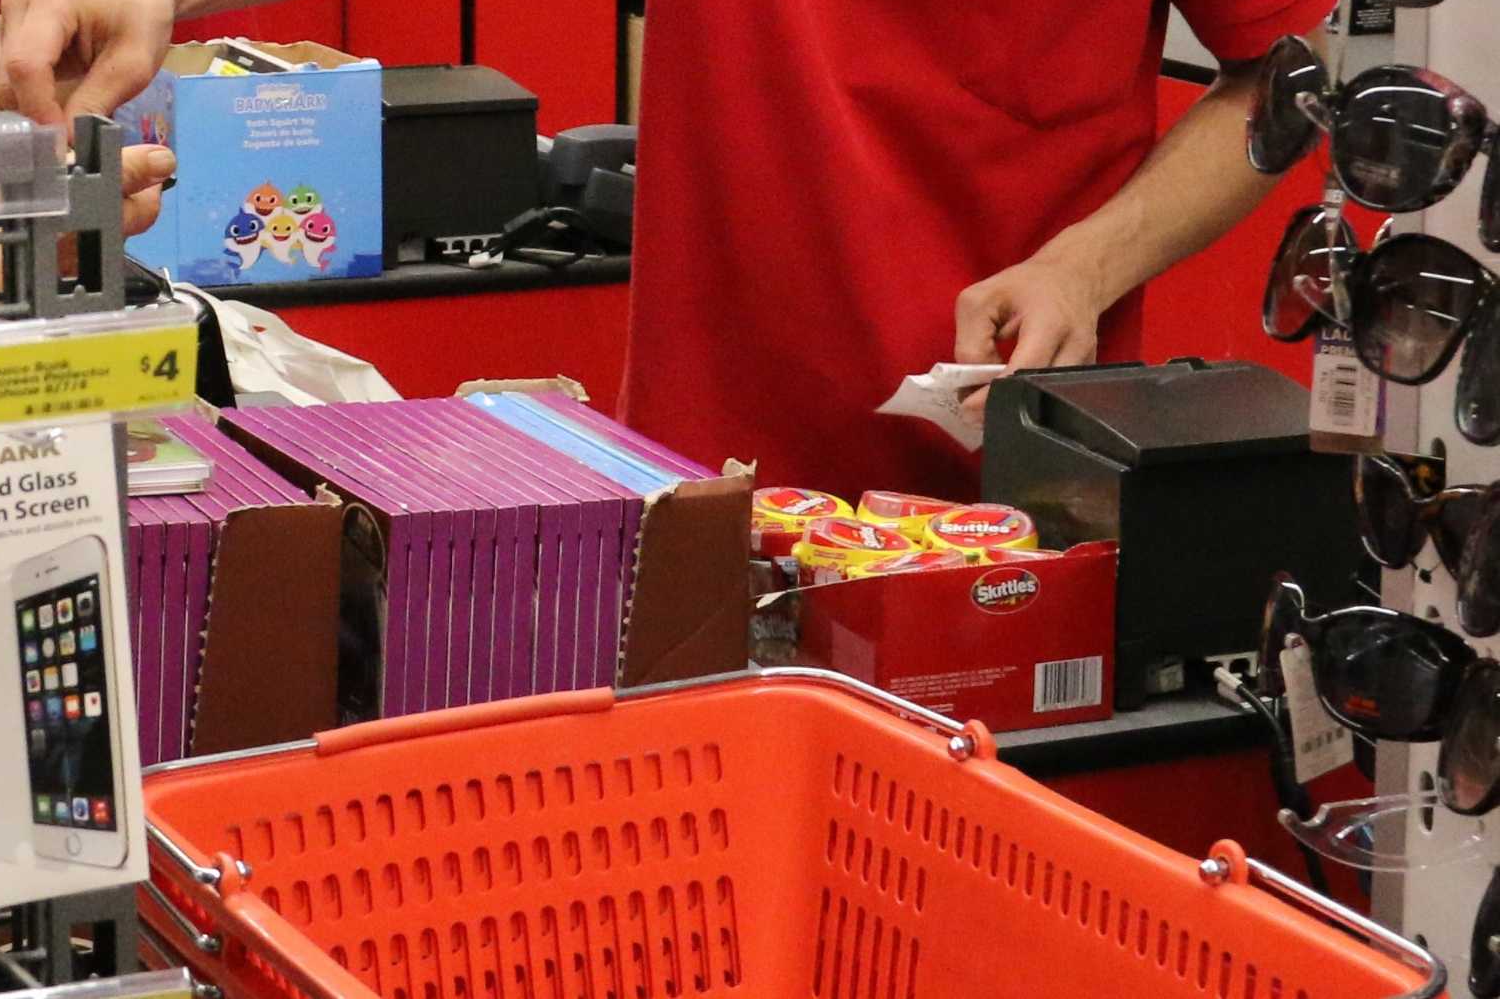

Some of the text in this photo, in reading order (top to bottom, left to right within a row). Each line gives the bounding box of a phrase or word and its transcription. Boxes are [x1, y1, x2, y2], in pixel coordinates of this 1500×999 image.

[140, 349, 180, 382] $4
[18, 470, 79, 493] Glass
[14, 494, 91, 520] Screen
[938, 520, 1013, 536] Skittles
[975, 579, 1037, 603] Skittles
